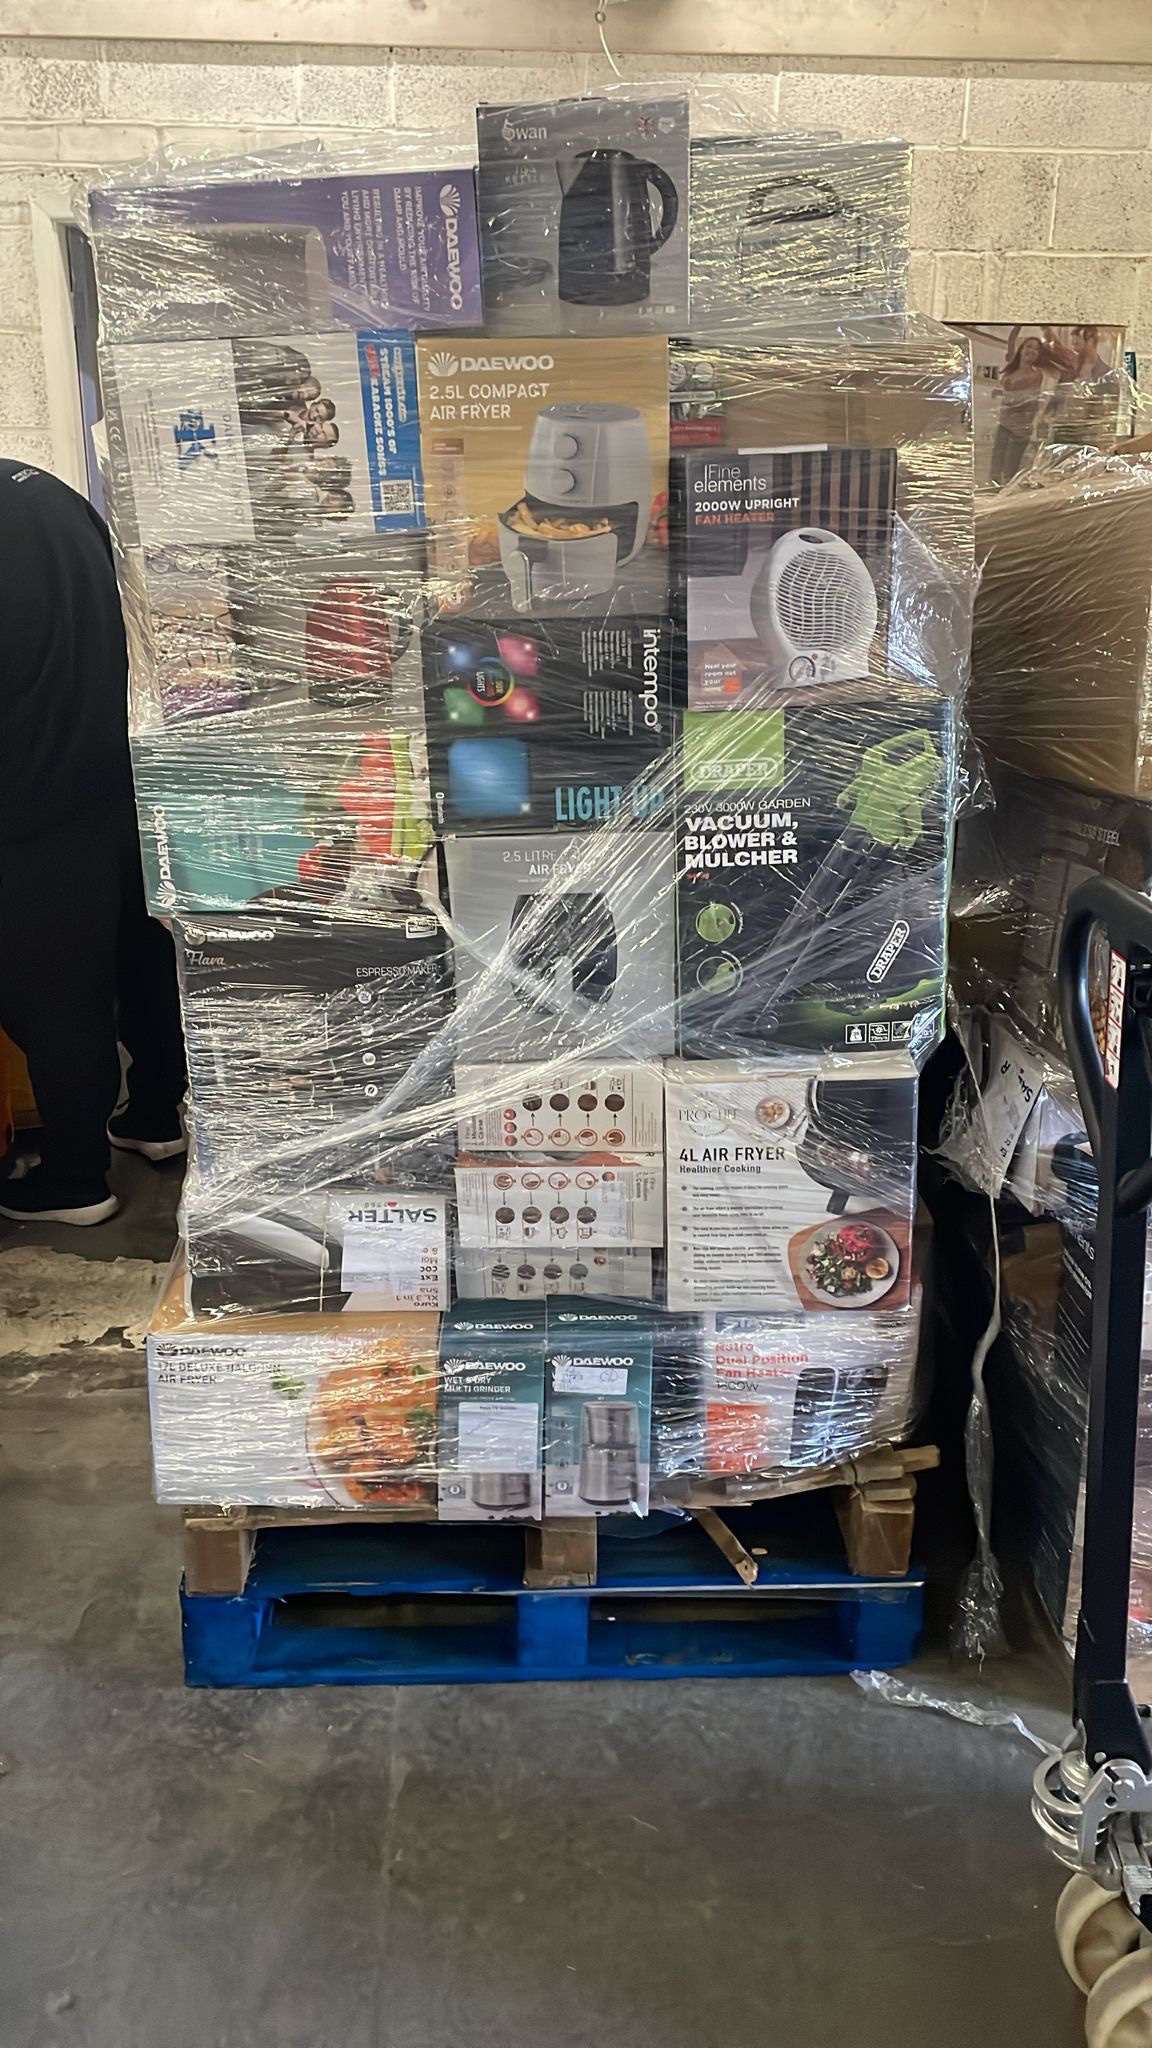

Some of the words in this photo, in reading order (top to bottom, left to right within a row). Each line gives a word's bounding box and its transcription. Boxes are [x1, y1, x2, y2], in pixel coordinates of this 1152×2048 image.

[502, 119, 547, 143] Swan
[341, 190, 350, 209] YOU
[362, 190, 371, 208] AND
[394, 187, 403, 214] DAMP
[404, 187, 412, 198] BY
[352, 190, 361, 220] LIVING
[415, 186, 425, 227] IMPROVE
[395, 217, 404, 235] AND
[405, 201, 415, 248] REDUCING
[445, 218, 462, 310] DAEWOO
[379, 347, 392, 396] STREAM
[461, 355, 554, 371] DAEWOO
[430, 386, 464, 400] 2.5L
[469, 383, 549, 397] COMPACT
[370, 377, 383, 435] KARAOKE
[430, 405, 455, 420] AIR
[461, 404, 511, 419] FRYER
[384, 399, 397, 437] 1000'S
[388, 440, 397, 454] OF
[375, 437, 387, 476] SONGS
[694, 467, 766, 493] elements
[708, 464, 741, 480] Fine
[695, 498, 741, 513] 2000W
[745, 497, 800, 510] UPRIGHT
[695, 513, 721, 525] FAN
[725, 511, 775, 524] HEATER
[476, 672, 485, 692] LIGHTS
[639, 629, 660, 727] intempo
[698, 761, 769, 779] DRAPER
[555, 786, 623, 821] LIGHT
[684, 804, 712, 813] 230V
[758, 797, 811, 810] GARDEN
[685, 813, 798, 832] VACUUM,
[153, 805, 171, 880] DAEWOO
[684, 832, 775, 850] BLOWER
[782, 831, 798, 845] &
[503, 851, 521, 862] 2.5
[525, 850, 557, 862] LITRE
[685, 849, 798, 869] MULCHER
[529, 865, 550, 875] AIR
[207, 929, 275, 941] DAEWOO
[186, 949, 225, 966] Flava
[871, 928, 907, 979] DRAPER
[356, 967, 405, 978] ESPRESSO
[408, 964, 438, 975] MAKER
[680, 1148, 698, 1162] 4L
[703, 1148, 728, 1161] AIR
[735, 1147, 785, 1160] FRYER
[680, 1166, 721, 1174] Healthier
[725, 1165, 761, 1174] Cooking
[348, 1209, 437, 1223] SALTER
[180, 1347, 246, 1356] DAEWOO
[716, 1342, 754, 1352] Retro
[178, 1363, 224, 1372] DELUXE
[465, 1362, 526, 1371] DAEWOO
[716, 1355, 747, 1364] Dual
[752, 1354, 808, 1364] Position
[158, 1375, 176, 1383] AIR
[180, 1375, 217, 1384] FRYER
[474, 1376, 491, 1384] DRY
[716, 1368, 741, 1377] Fan
